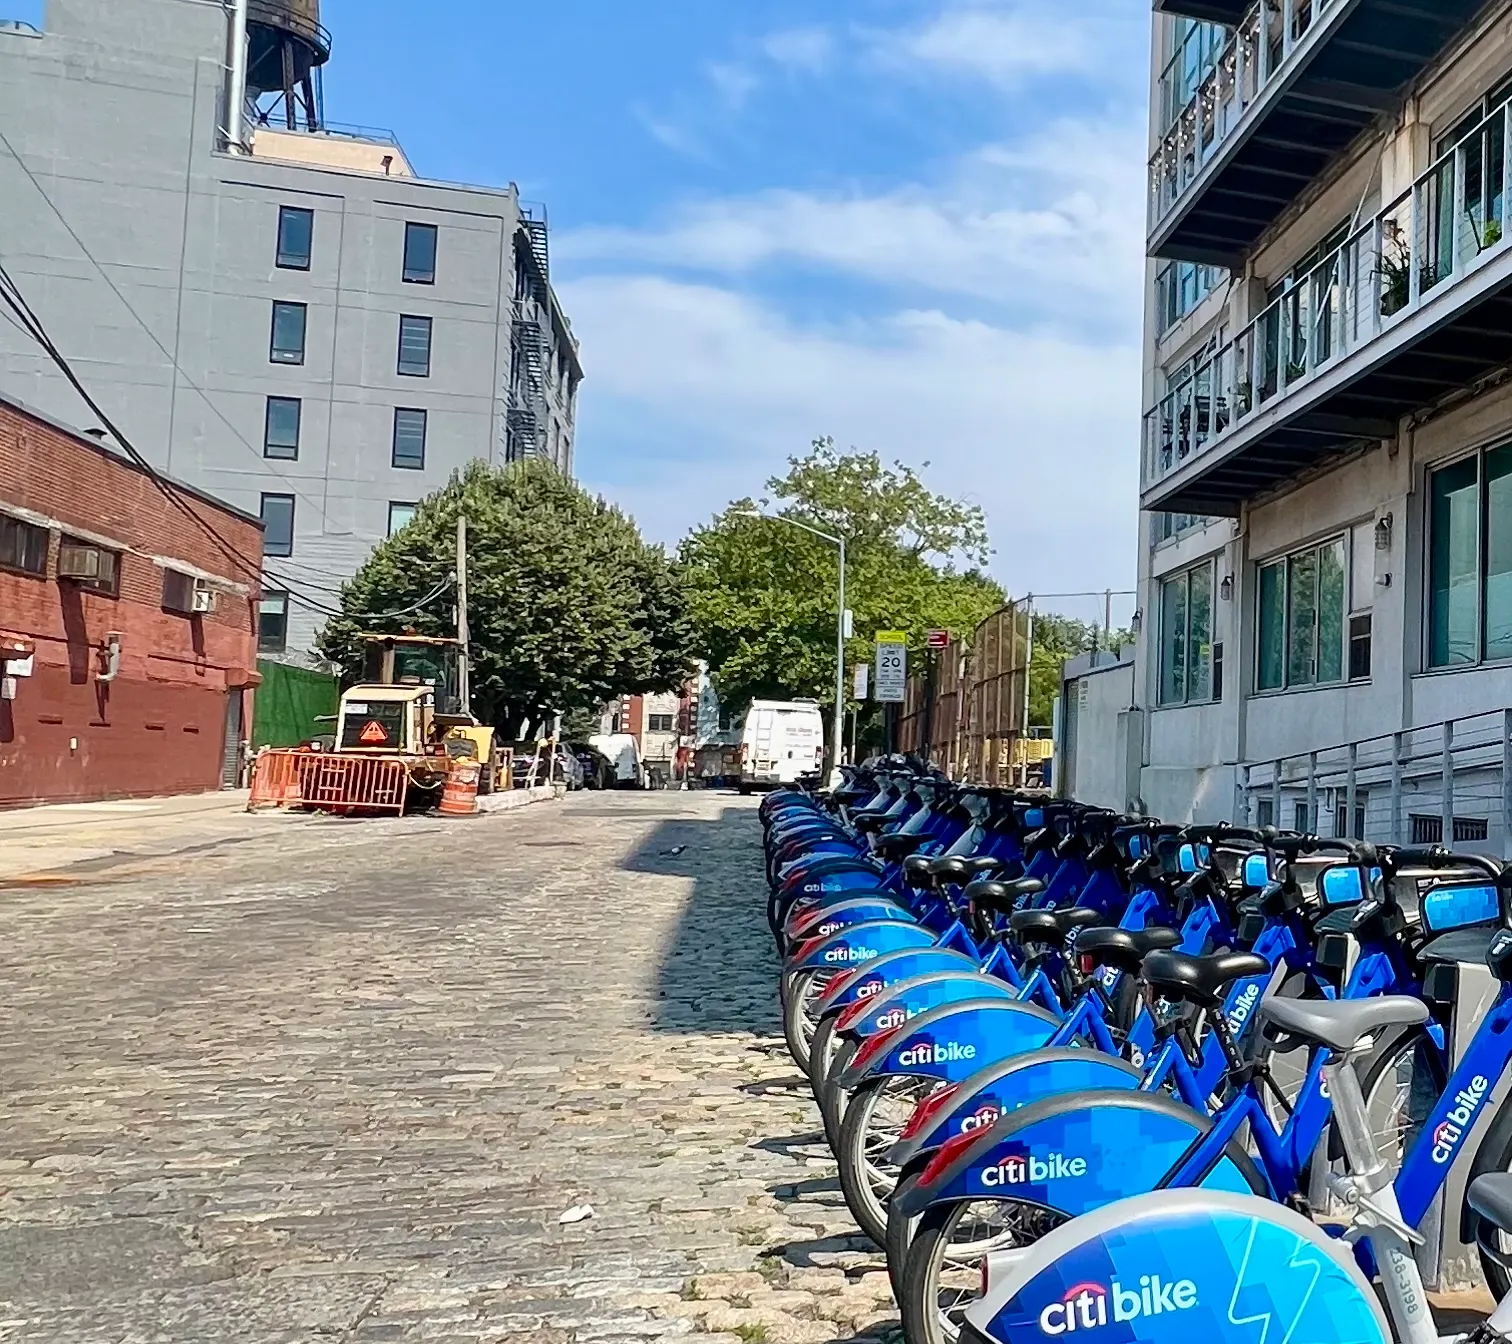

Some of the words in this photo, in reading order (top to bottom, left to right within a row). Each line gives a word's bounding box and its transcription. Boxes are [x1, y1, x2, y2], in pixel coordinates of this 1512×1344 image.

[881, 657, 901, 668] 20
[1229, 984, 1260, 1022] bike
[898, 1043, 933, 1067] citi
[933, 1042, 977, 1063] bike
[1446, 1074, 1488, 1127] bike
[1432, 1120, 1462, 1164] citi
[981, 1156, 1026, 1187] citi
[1029, 1152, 1088, 1182] bike
[1039, 1283, 1107, 1335] citi
[1111, 1274, 1199, 1323] bike
